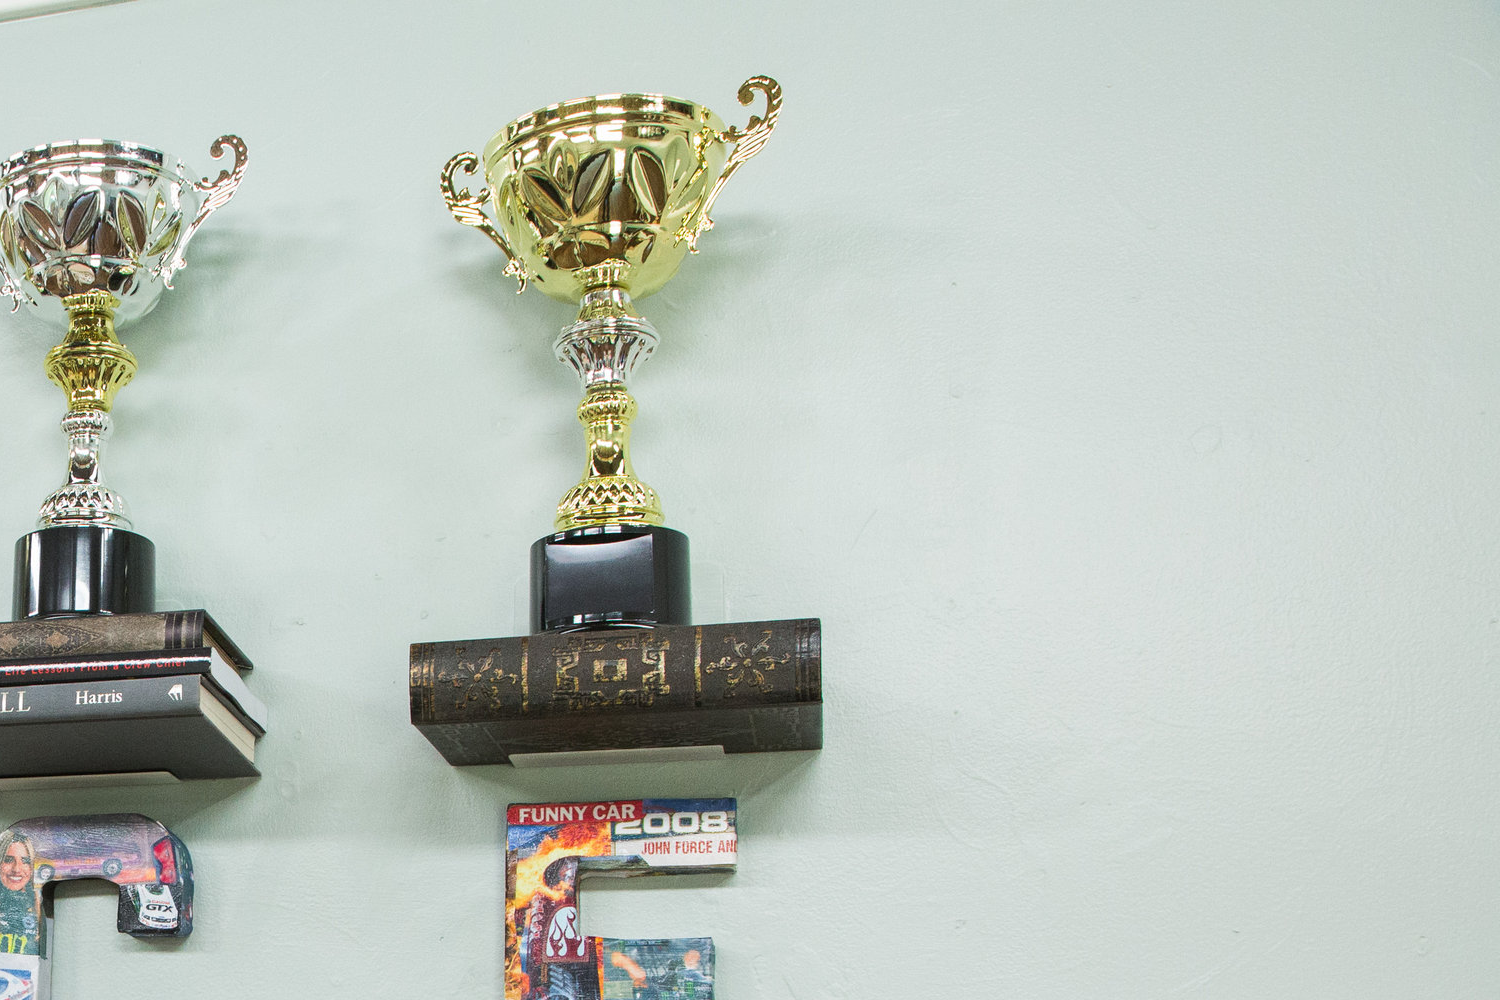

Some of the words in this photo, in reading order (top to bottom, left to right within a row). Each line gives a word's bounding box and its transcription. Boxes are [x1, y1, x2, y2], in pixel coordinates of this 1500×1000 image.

[75, 688, 123, 706] Harris
[519, 806, 586, 823] FUNNY
[592, 803, 636, 820] CAR
[641, 841, 670, 855] JOHN
[675, 840, 713, 854] FORCE
[145, 903, 173, 913] GTX
